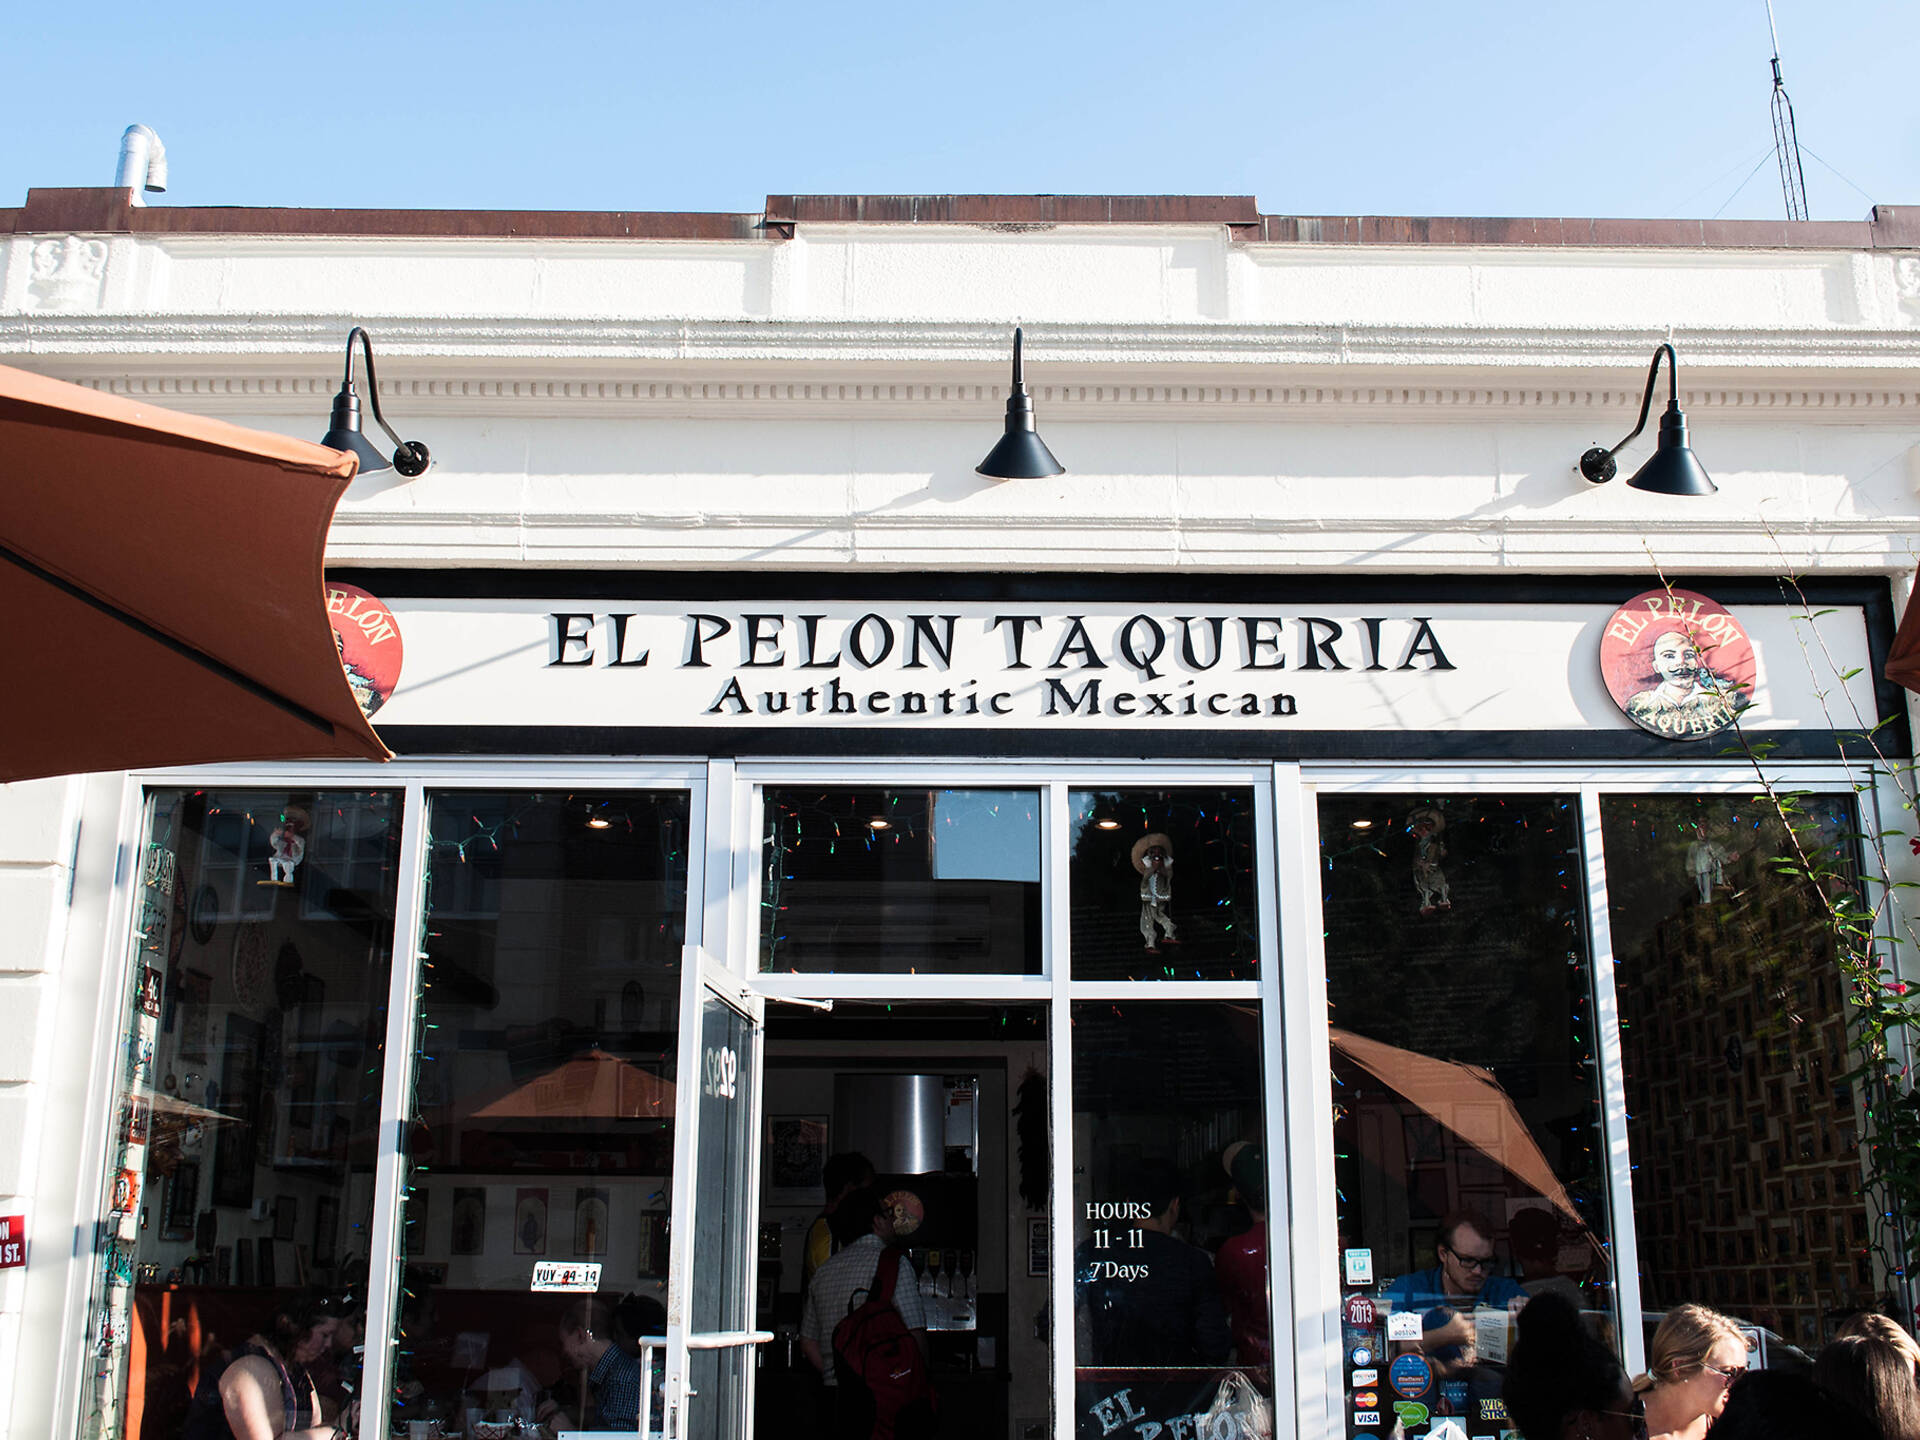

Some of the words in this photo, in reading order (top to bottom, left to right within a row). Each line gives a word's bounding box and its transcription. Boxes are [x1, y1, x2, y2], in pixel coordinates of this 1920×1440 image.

[1607, 611, 1650, 647] EL
[549, 613, 649, 667] EL
[683, 613, 961, 669] PELON
[994, 614, 1457, 681] TAQUERIA
[709, 676, 1014, 715] Authentic
[1045, 678, 1298, 716] Mexican
[1086, 1202, 1152, 1220] HOURS
[1093, 1229, 1110, 1249] 11
[1127, 1229, 1144, 1248] 11
[1089, 1262, 1101, 1279] 7
[1105, 1261, 1149, 1283] Days
[1351, 1304, 1373, 1324] 2013
[1088, 1388, 1147, 1436] EL
[1356, 1414, 1379, 1423] VISA
